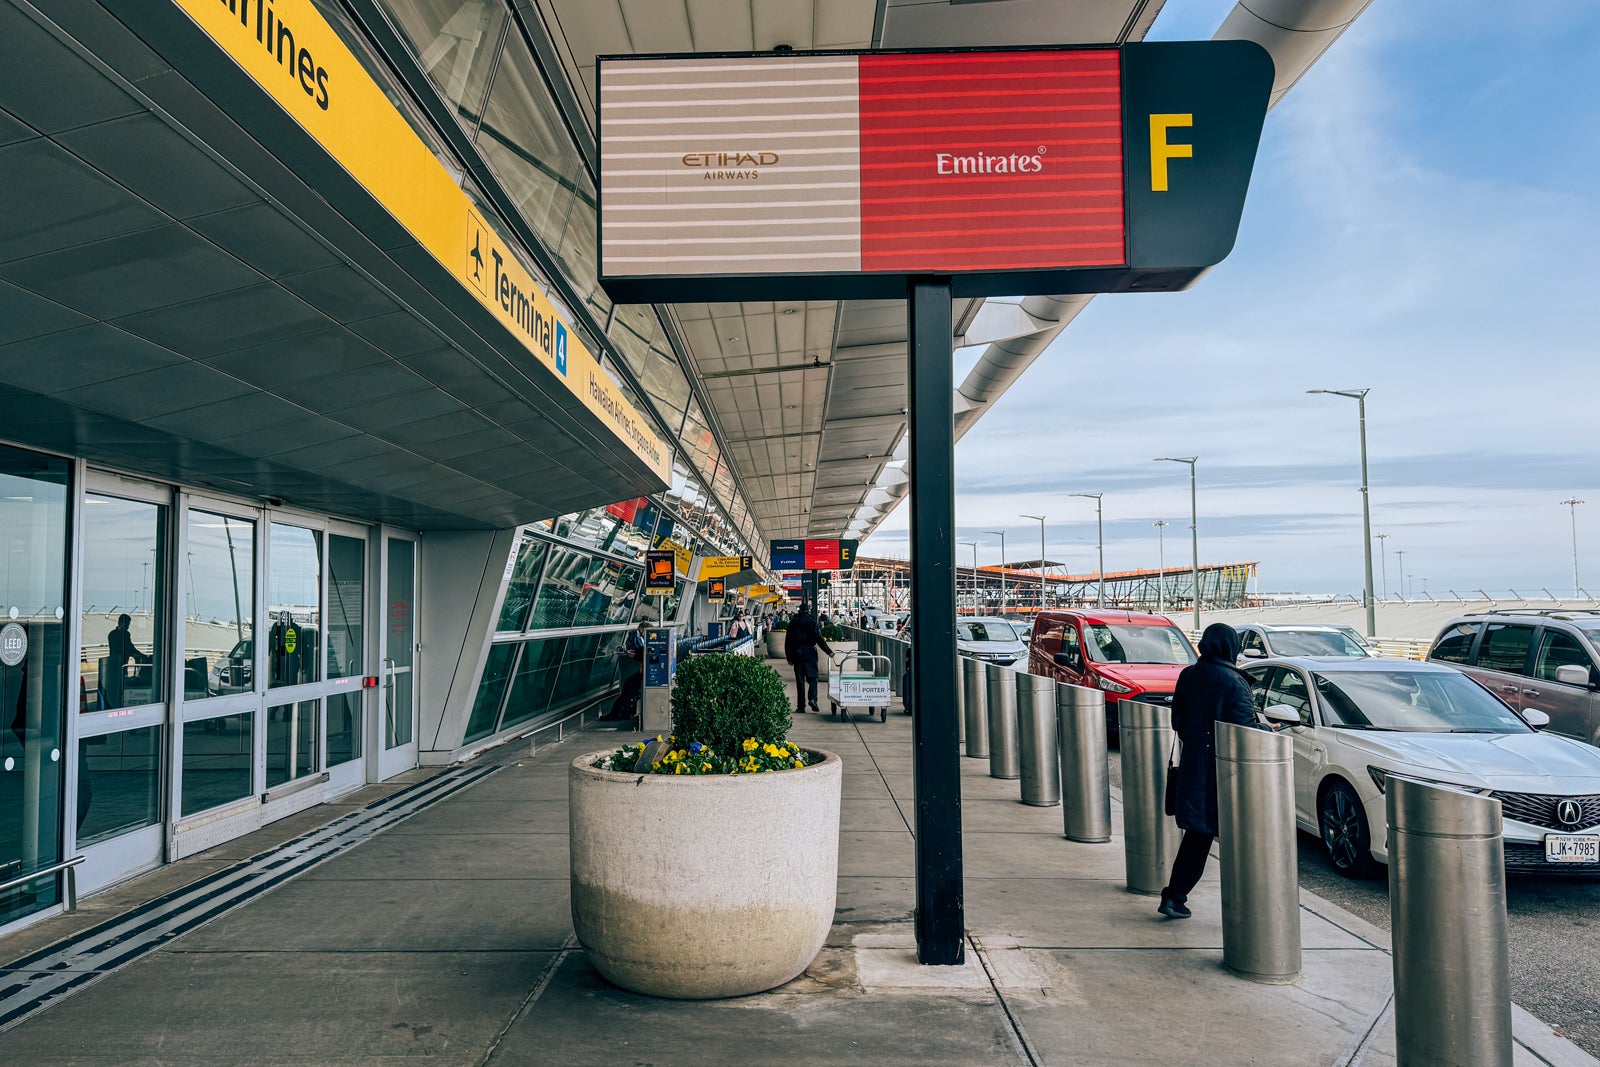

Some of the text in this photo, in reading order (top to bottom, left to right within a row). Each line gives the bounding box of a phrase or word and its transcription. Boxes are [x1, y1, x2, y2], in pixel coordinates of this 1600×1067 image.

[1149, 113, 1193, 192] F
[682, 152, 780, 167] ETIHAD
[936, 151, 1043, 175] Emirates
[704, 170, 759, 180] AIRWAYS
[491, 247, 565, 367] Terminal 4
[589, 370, 615, 418] Hawaiian
[841, 548, 850, 560] E
[743, 557, 750, 568] E
[820, 577, 827, 585] D
[4, 638, 22, 650] LEED
